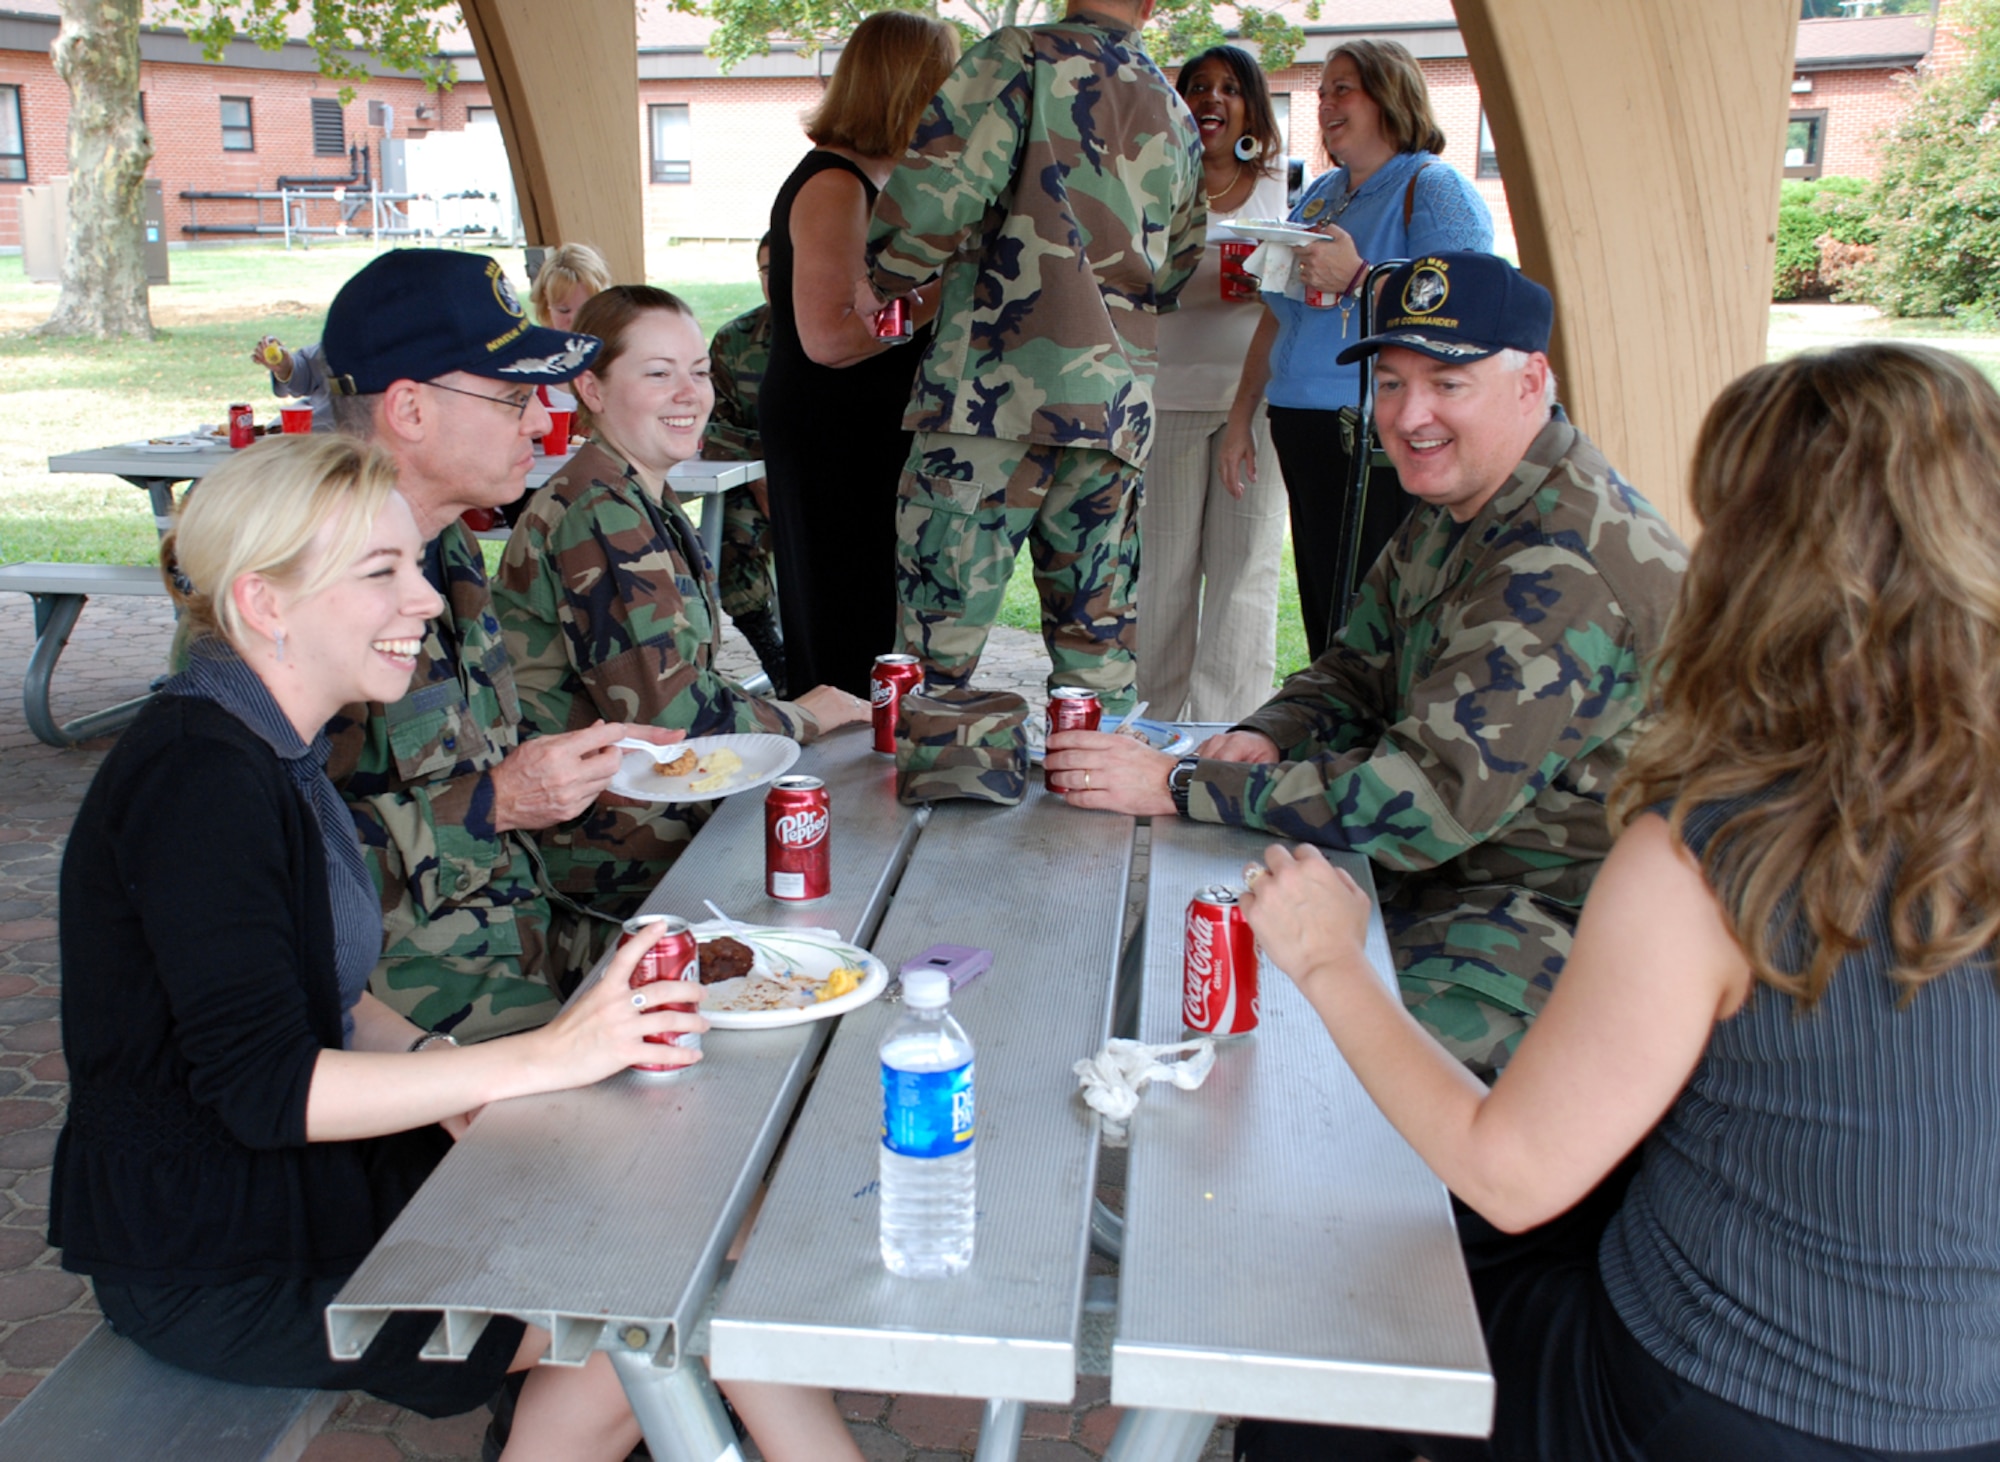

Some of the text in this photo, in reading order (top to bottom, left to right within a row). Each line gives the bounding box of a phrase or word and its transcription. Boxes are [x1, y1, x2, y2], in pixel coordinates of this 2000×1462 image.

[1400, 316, 1459, 329] COMMANDER
[779, 814, 827, 845] Pepper
[795, 810, 817, 828] Dr
[1213, 958, 1223, 991] classic
